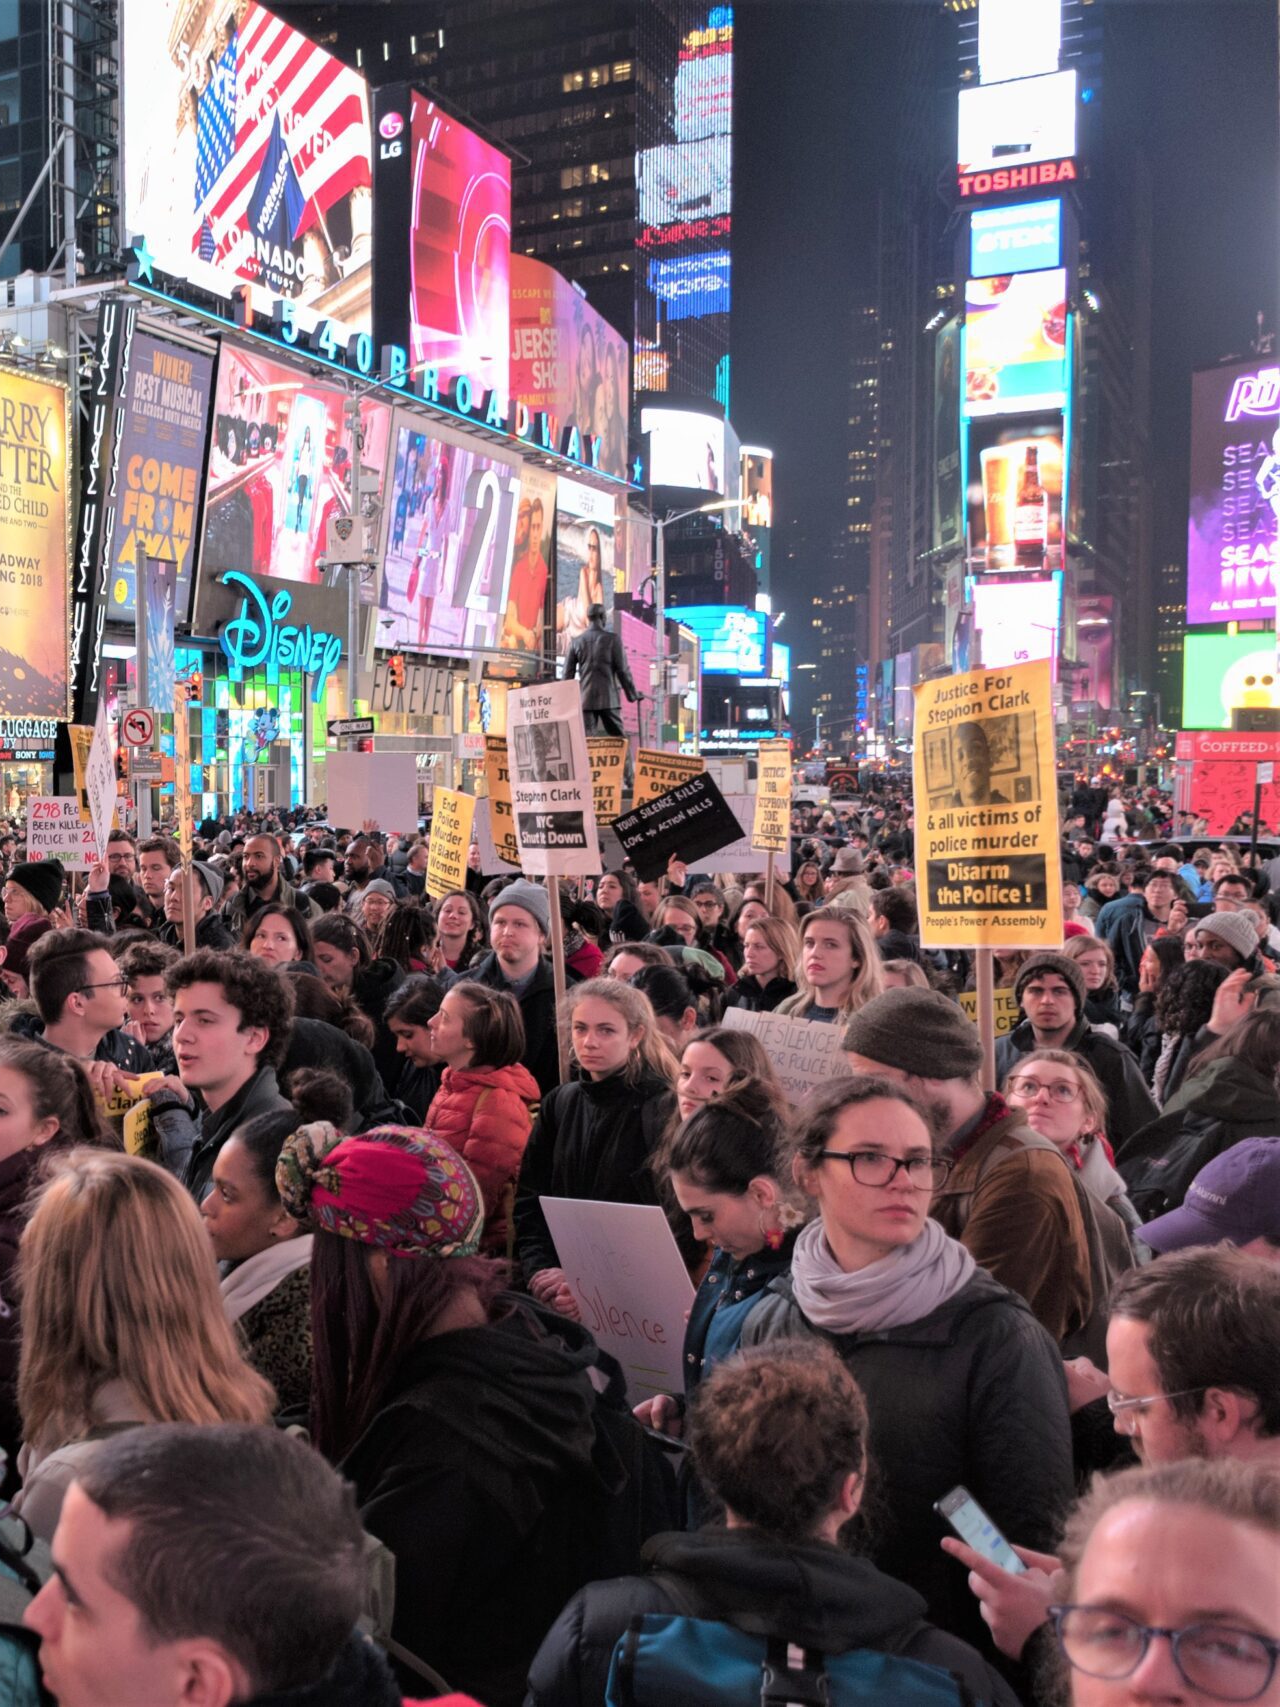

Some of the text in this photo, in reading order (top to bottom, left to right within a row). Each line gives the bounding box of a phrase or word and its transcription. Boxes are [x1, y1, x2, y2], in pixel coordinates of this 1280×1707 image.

[380, 141, 402, 160] LG
[959, 160, 1076, 196] TOSHIBA
[512, 288, 541, 299] ESCAPE
[152, 350, 193, 386] WINNER!
[239, 284, 603, 467] 1540 BROADWAY
[133, 371, 203, 417] BEST MUSICAL
[132, 400, 142, 416] ALL
[143, 402, 163, 422] ACROSS
[164, 408, 180, 427] NORTH
[180, 412, 202, 432] AMERICA
[127, 453, 197, 503] COME
[9, 484, 22, 496] THE
[14, 497, 49, 518] CHILD
[10, 517, 23, 527] AND
[23, 519, 37, 529] TWO
[118, 528, 191, 574] AWAY
[20, 571, 43, 587] 2018
[1014, 650, 1029, 659] US
[371, 660, 454, 715] FOREVER
[934, 675, 1013, 704] Justice For
[538, 695, 552, 705] For
[928, 690, 1030, 725] Stephon Clark
[534, 708, 549, 719] Life
[340, 721, 371, 731] ONE WAY
[15, 751, 37, 759] SONY
[1200, 741, 1268, 753] COFFEED
[550, 788, 581, 801] Clark
[32, 802, 61, 819] 298
[442, 797, 458, 813] End
[616, 779, 705, 831] YOUR SILENCE KILLS
[32, 820, 56, 831] BEEN
[438, 811, 460, 831] Police
[536, 815, 554, 829] NYC
[623, 797, 713, 849] LOVE ACTION KILLS
[927, 805, 1042, 831] & all victims of
[32, 833, 78, 845] POLICE IN
[434, 825, 462, 846] Murder
[521, 831, 540, 844] Shut
[548, 831, 583, 844] Down
[930, 832, 1038, 858] police murder
[29, 851, 43, 863] NO
[431, 842, 461, 863] of Black
[430, 856, 460, 878] Women
[948, 862, 1010, 881] Disarm
[937, 884, 1021, 905] the Police
[926, 915, 1047, 928] People's Power Assembly
[774, 1022, 835, 1054] SILENCE
[788, 1053, 828, 1075] POLICE
[576, 1277, 667, 1344] Silence
